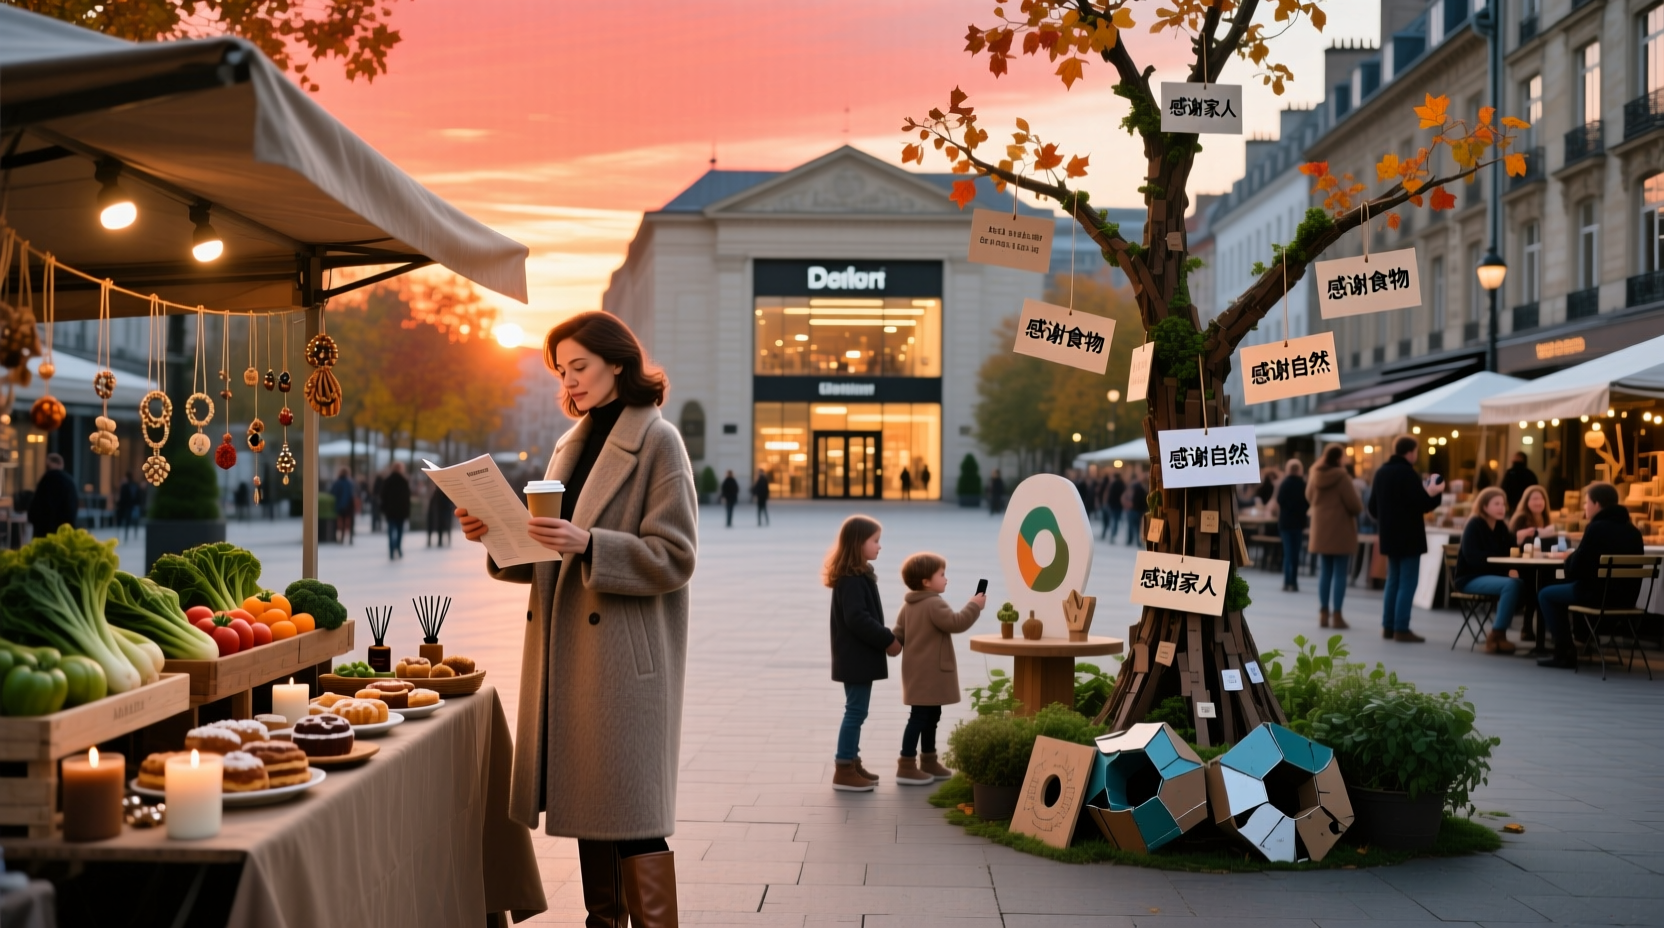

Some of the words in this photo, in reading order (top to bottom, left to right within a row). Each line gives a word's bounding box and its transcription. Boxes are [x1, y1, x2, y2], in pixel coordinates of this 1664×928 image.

[1169, 97, 1237, 118] 感谢家人
[1327, 267, 1410, 300] 感谢食物
[1025, 318, 1105, 354] 感谢食物
[1251, 350, 1331, 385] 感谢自然
[1169, 442, 1250, 470] 感谢自然
[1140, 566, 1217, 597] 感谢家人
